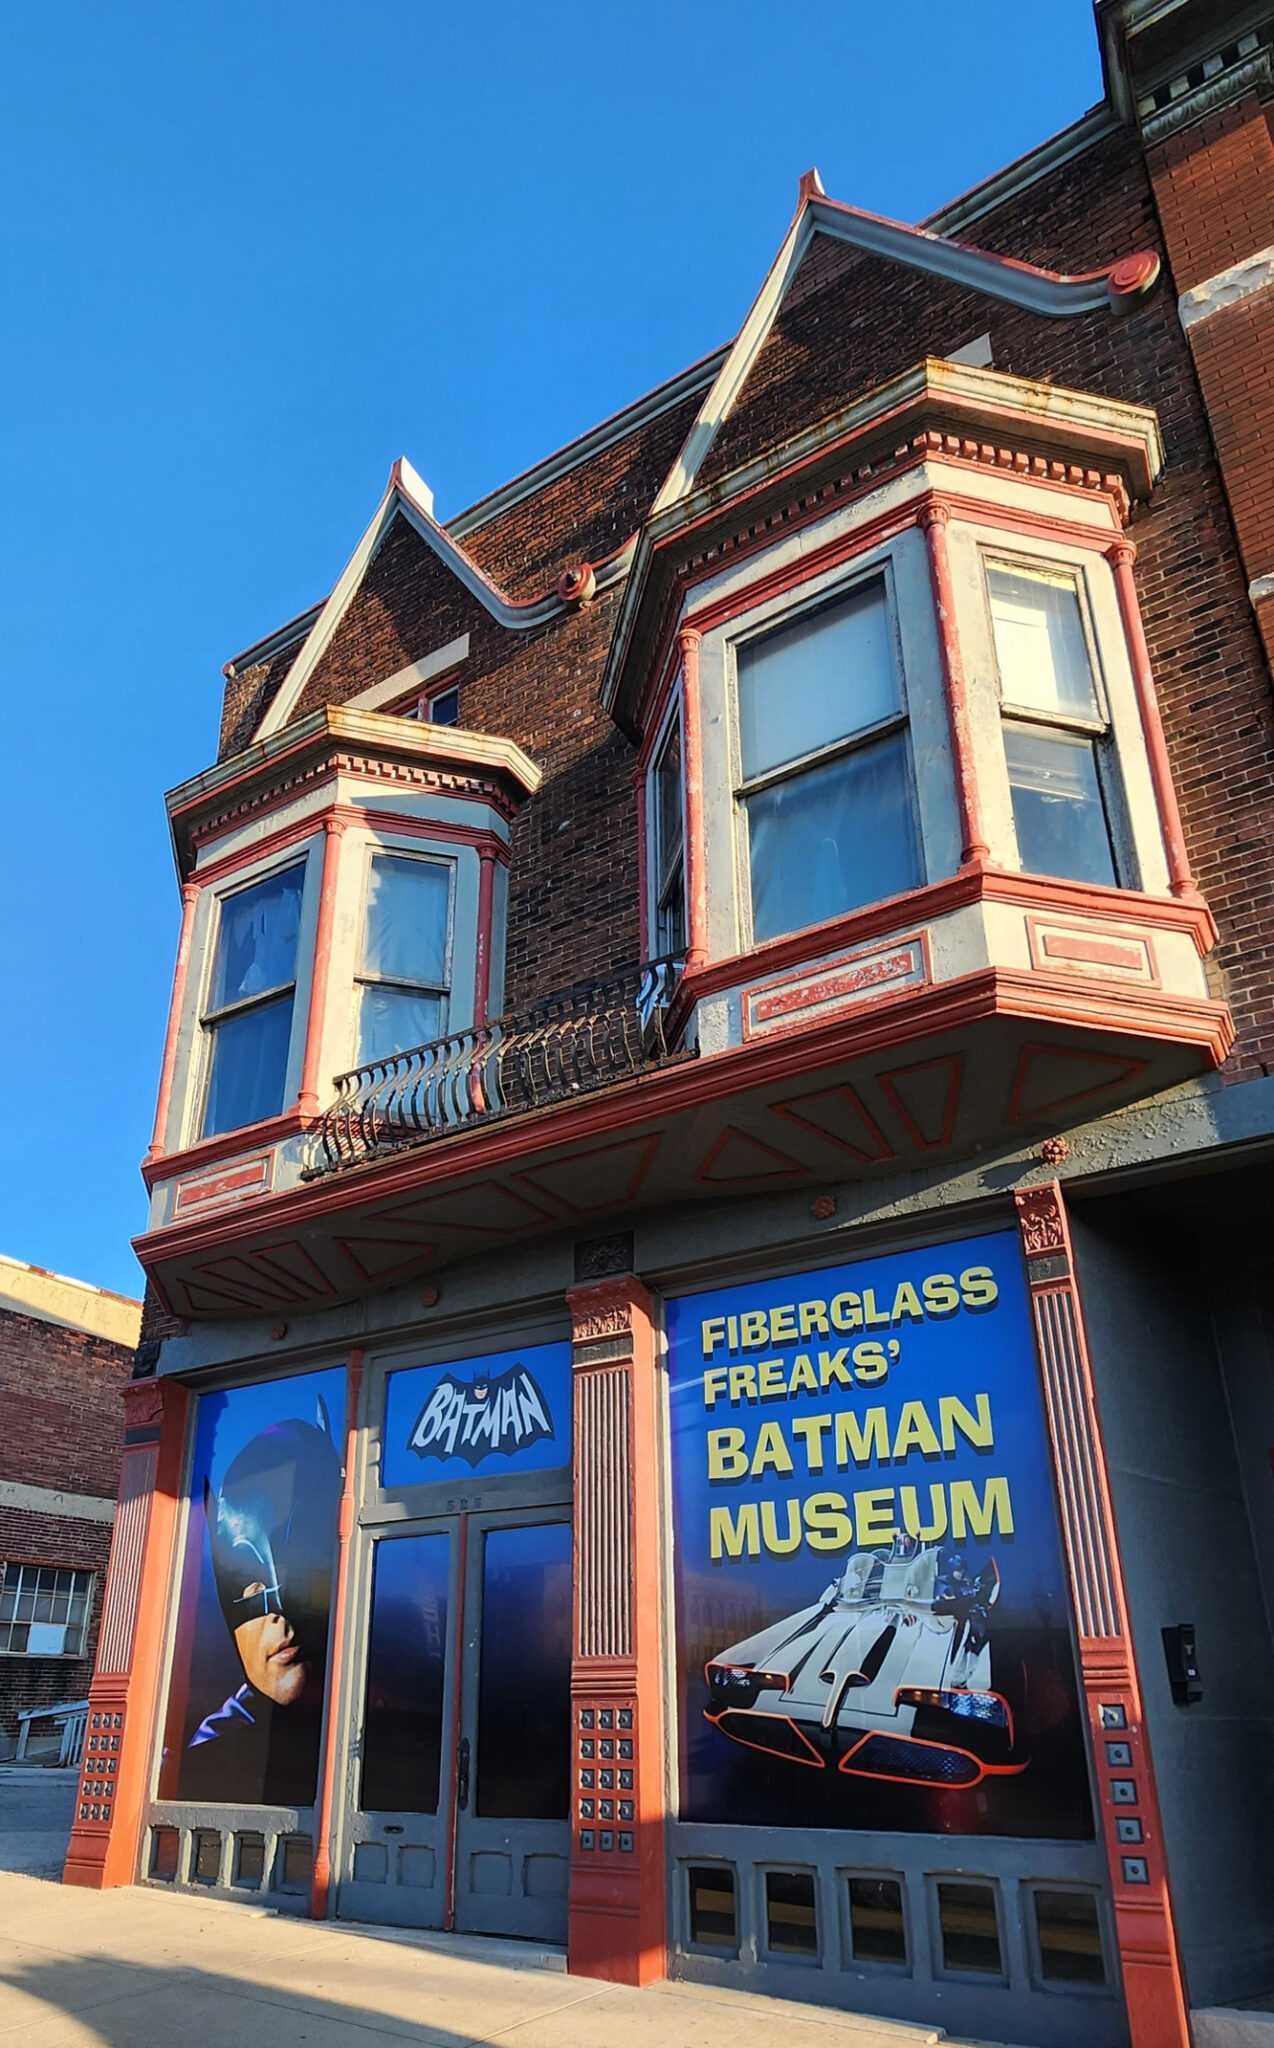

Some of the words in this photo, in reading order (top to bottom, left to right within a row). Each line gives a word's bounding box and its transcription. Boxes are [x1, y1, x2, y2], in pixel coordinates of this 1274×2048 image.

[702, 1266, 998, 1355] FIBERGLASS
[411, 1372, 552, 1455] BATMAN
[707, 1393, 994, 1480] BATMAN
[709, 1476, 1015, 1559] MUSEUM
